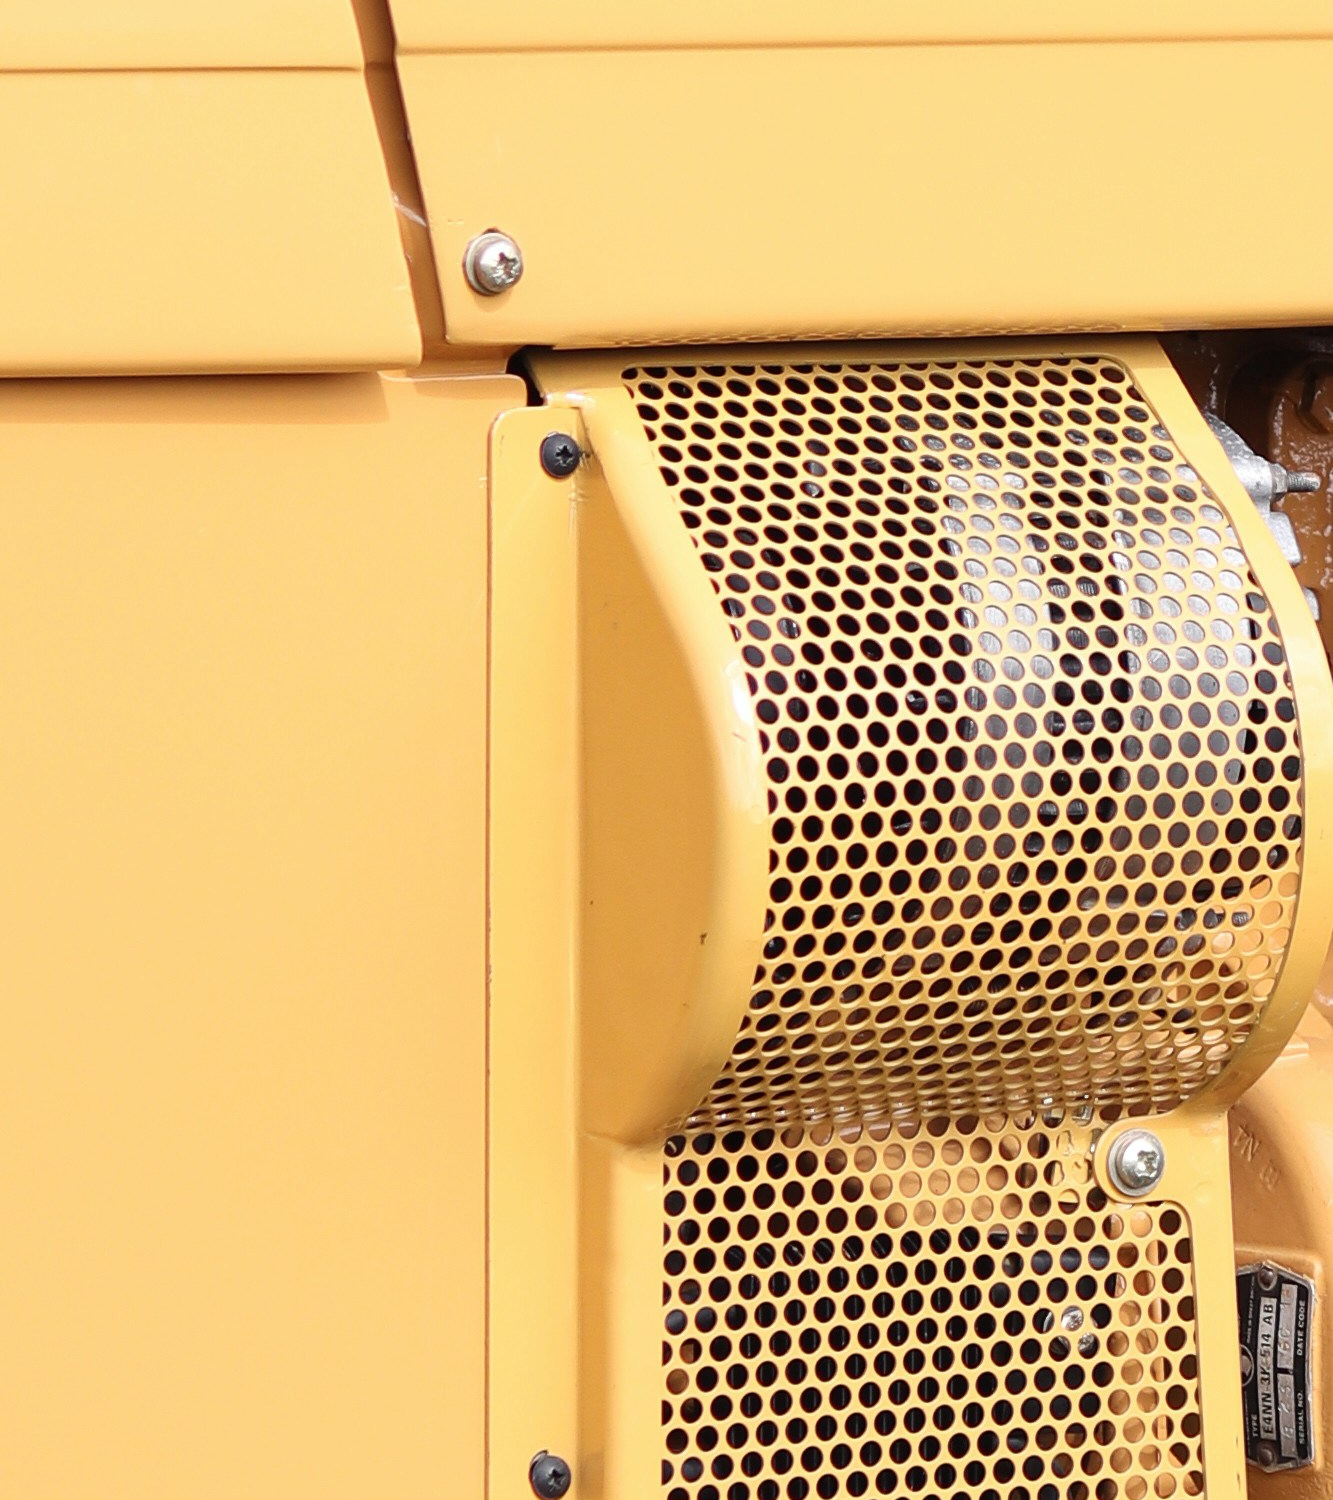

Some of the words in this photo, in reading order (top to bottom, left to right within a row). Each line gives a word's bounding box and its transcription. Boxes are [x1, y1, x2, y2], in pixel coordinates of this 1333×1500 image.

[1262, 1304, 1274, 1326] AB
[1297, 1299, 1306, 1328] CODE
[1296, 1330, 1305, 1356] DATE
[1250, 1413, 1259, 1437] TYPE
[1297, 1410, 1305, 1445] SERIAL
